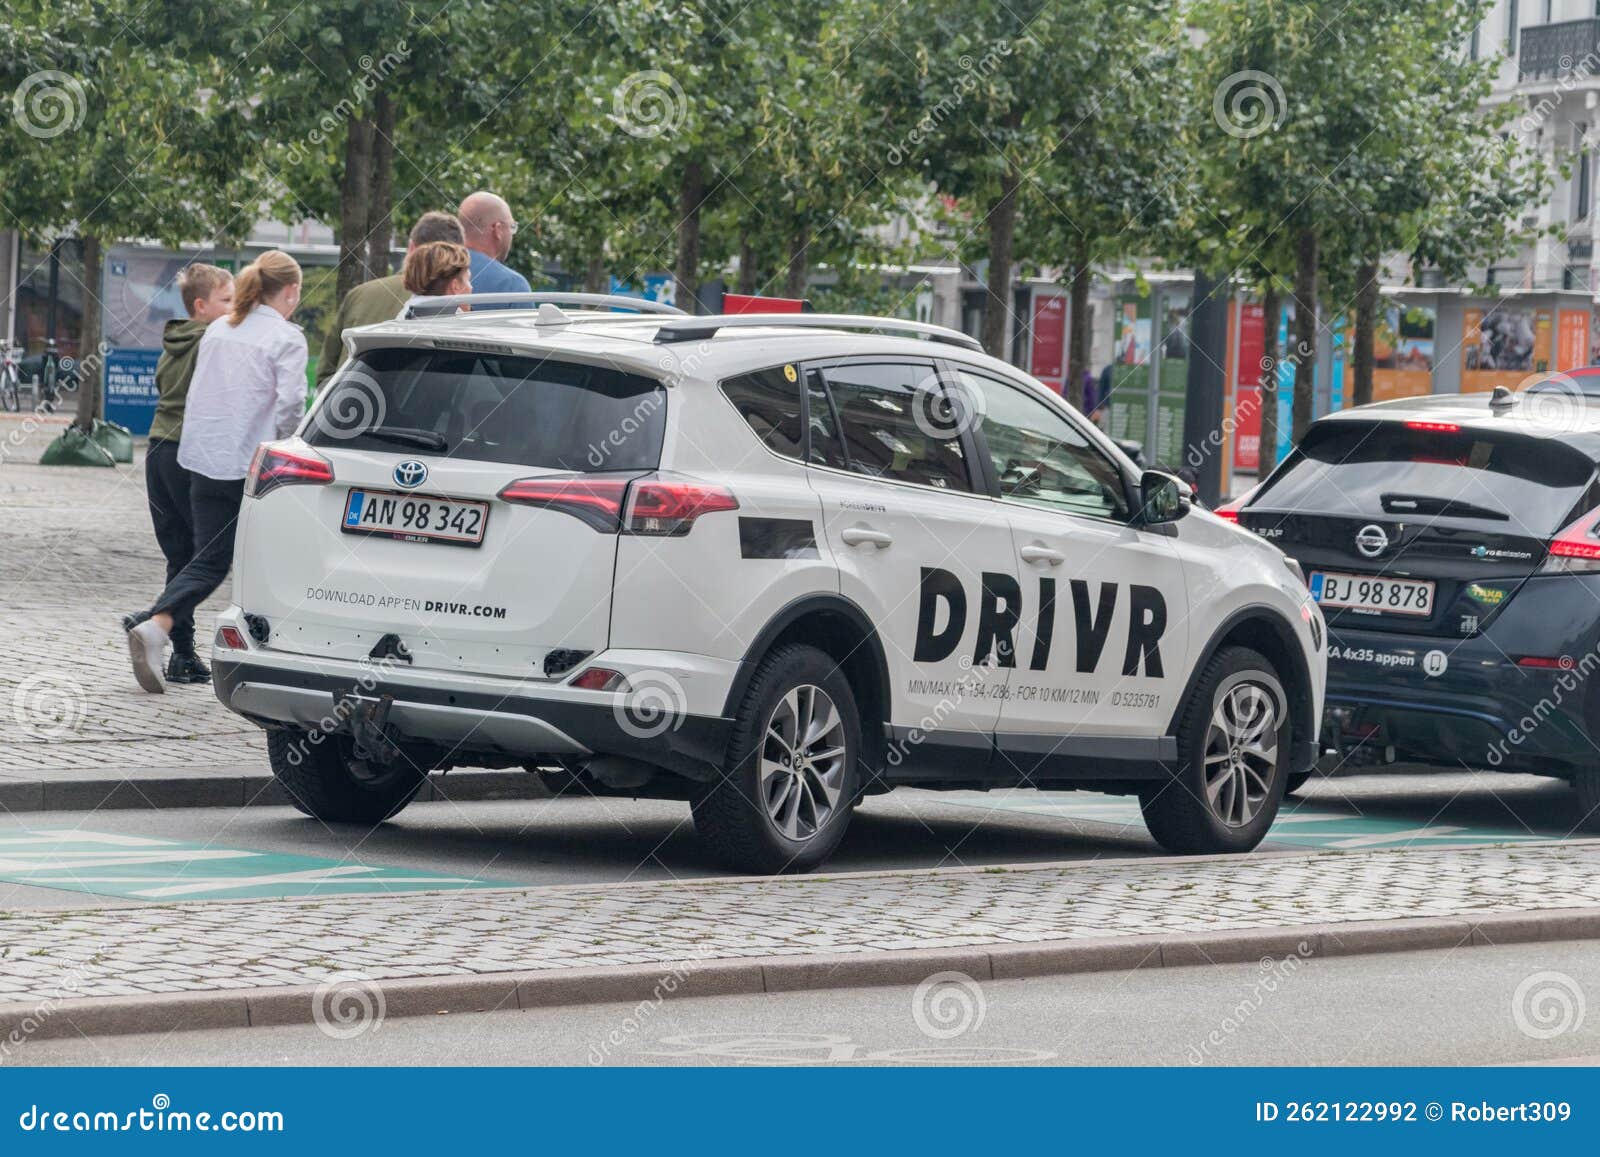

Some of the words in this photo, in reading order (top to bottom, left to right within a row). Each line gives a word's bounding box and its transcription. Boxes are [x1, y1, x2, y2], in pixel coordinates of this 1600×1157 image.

[362, 498, 396, 525] AN
[402, 502, 431, 529] 98
[435, 505, 482, 535] 342
[306, 587, 376, 606] DOWNLOAD
[378, 595, 421, 611] APP'EN
[424, 601, 507, 619] DRIVR.COM
[1324, 579, 1353, 601] BJ
[1359, 581, 1384, 604] 98
[1388, 584, 1429, 608] 878
[913, 566, 1167, 678] DRIVR
[1342, 647, 1374, 662] 4x35
[1375, 653, 1415, 667] appen
[907, 679, 950, 697] MIN/MAX
[1016, 685, 1038, 701] FOR
[1039, 687, 1050, 702] 10
[1050, 688, 1081, 704] KM/12
[1080, 689, 1100, 705] MIN
[1112, 691, 1122, 706] ID
